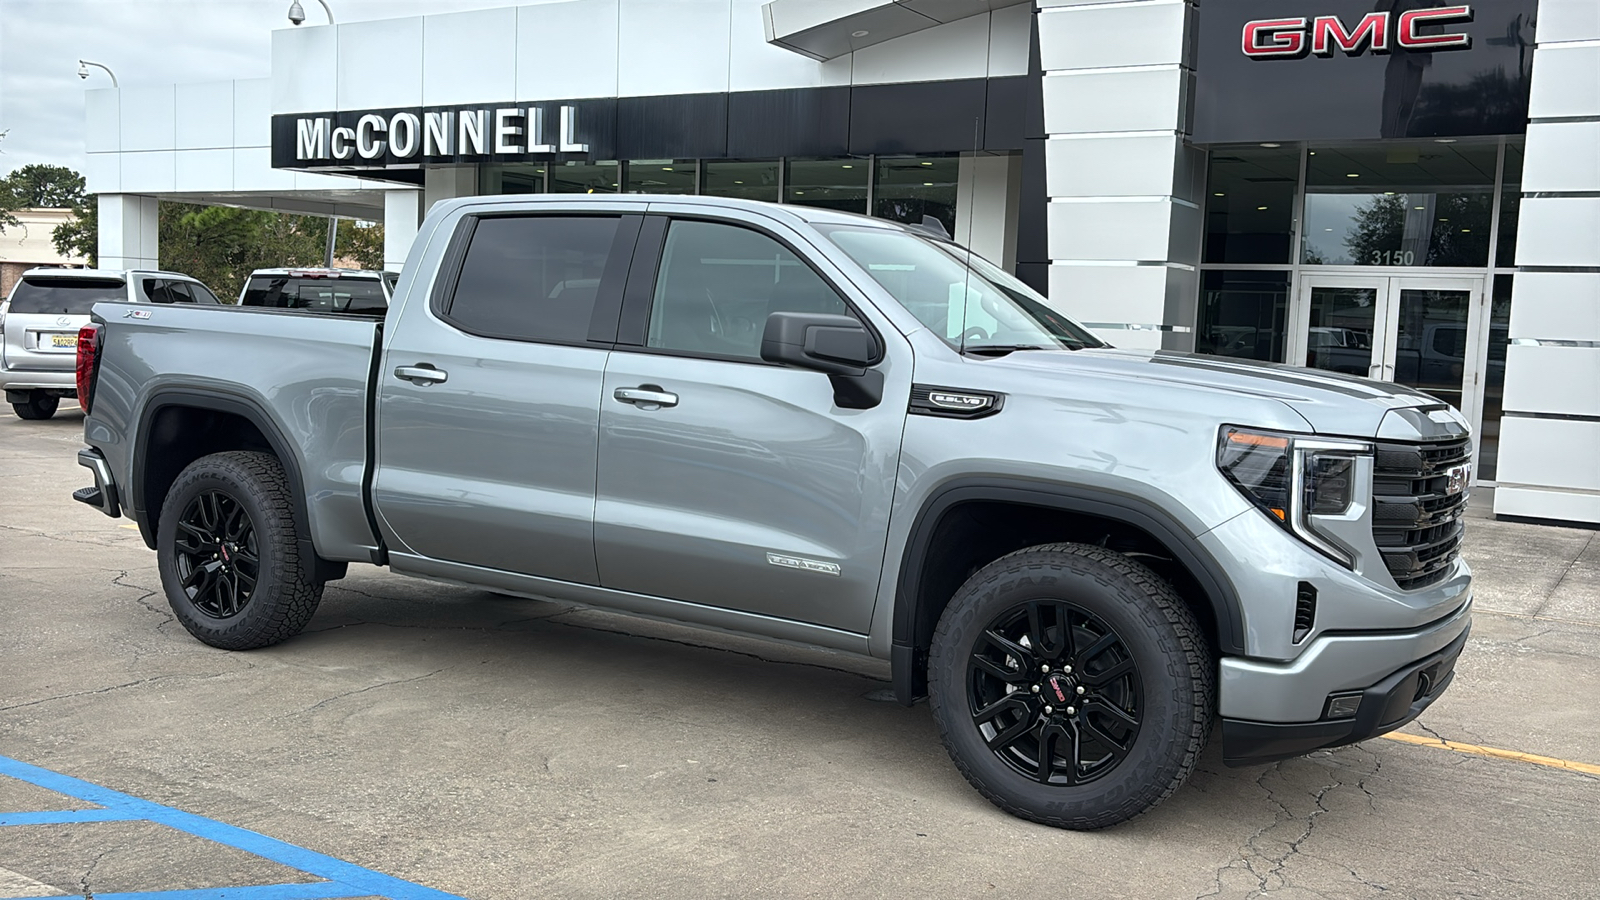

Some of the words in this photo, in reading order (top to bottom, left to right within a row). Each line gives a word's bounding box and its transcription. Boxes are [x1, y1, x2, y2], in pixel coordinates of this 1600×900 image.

[1242, 5, 1471, 57] GMC
[297, 105, 588, 160] McCONNELL
[1371, 250, 1414, 266] 3150
[944, 575, 1059, 687] GOODYEAR
